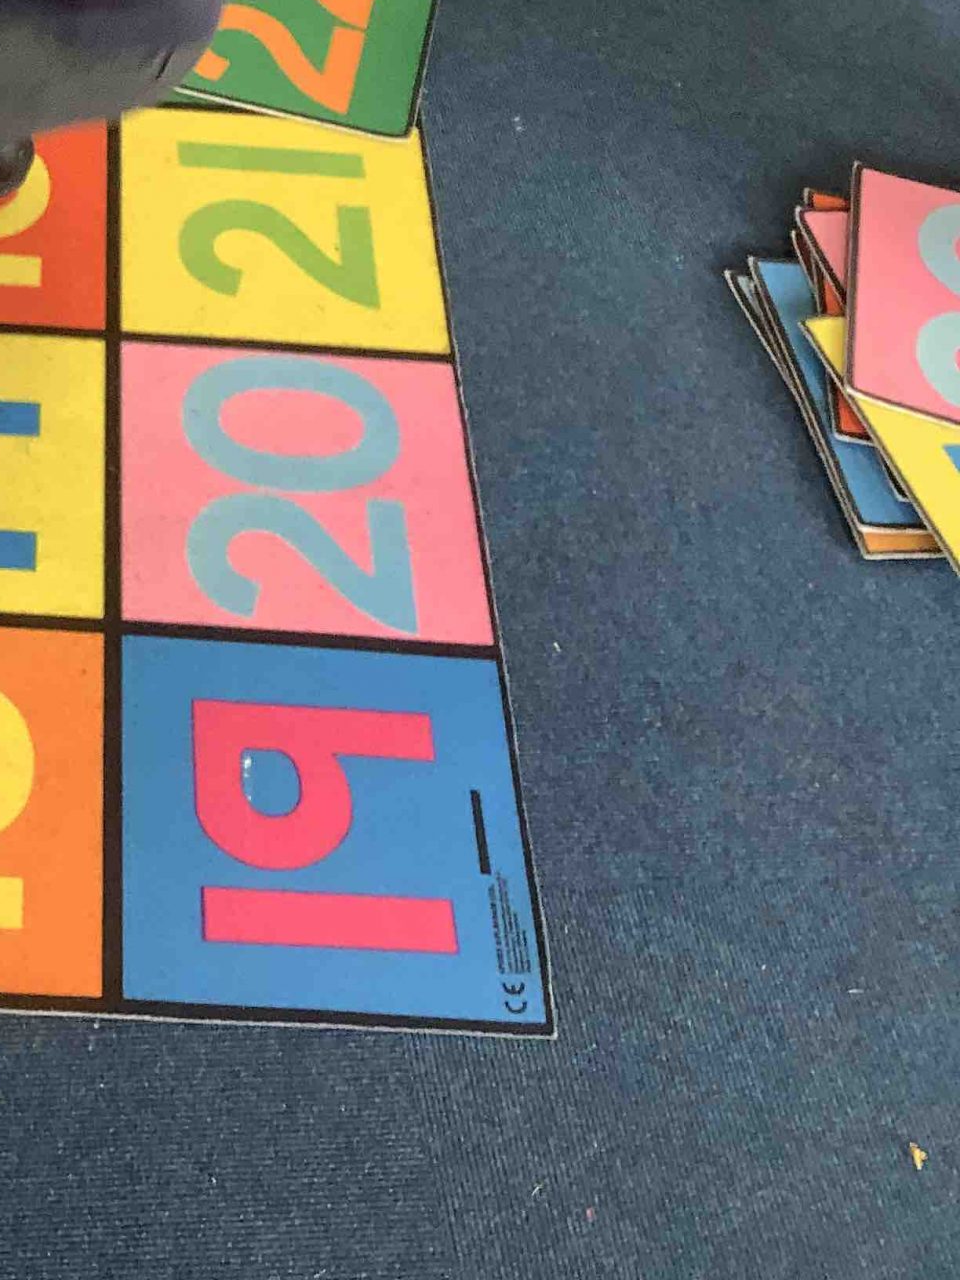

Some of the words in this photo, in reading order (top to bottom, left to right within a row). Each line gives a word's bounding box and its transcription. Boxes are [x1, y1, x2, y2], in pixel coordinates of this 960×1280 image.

[177, 141, 381, 310] 21
[182, 354, 419, 636] 20
[192, 699, 460, 955] 19
